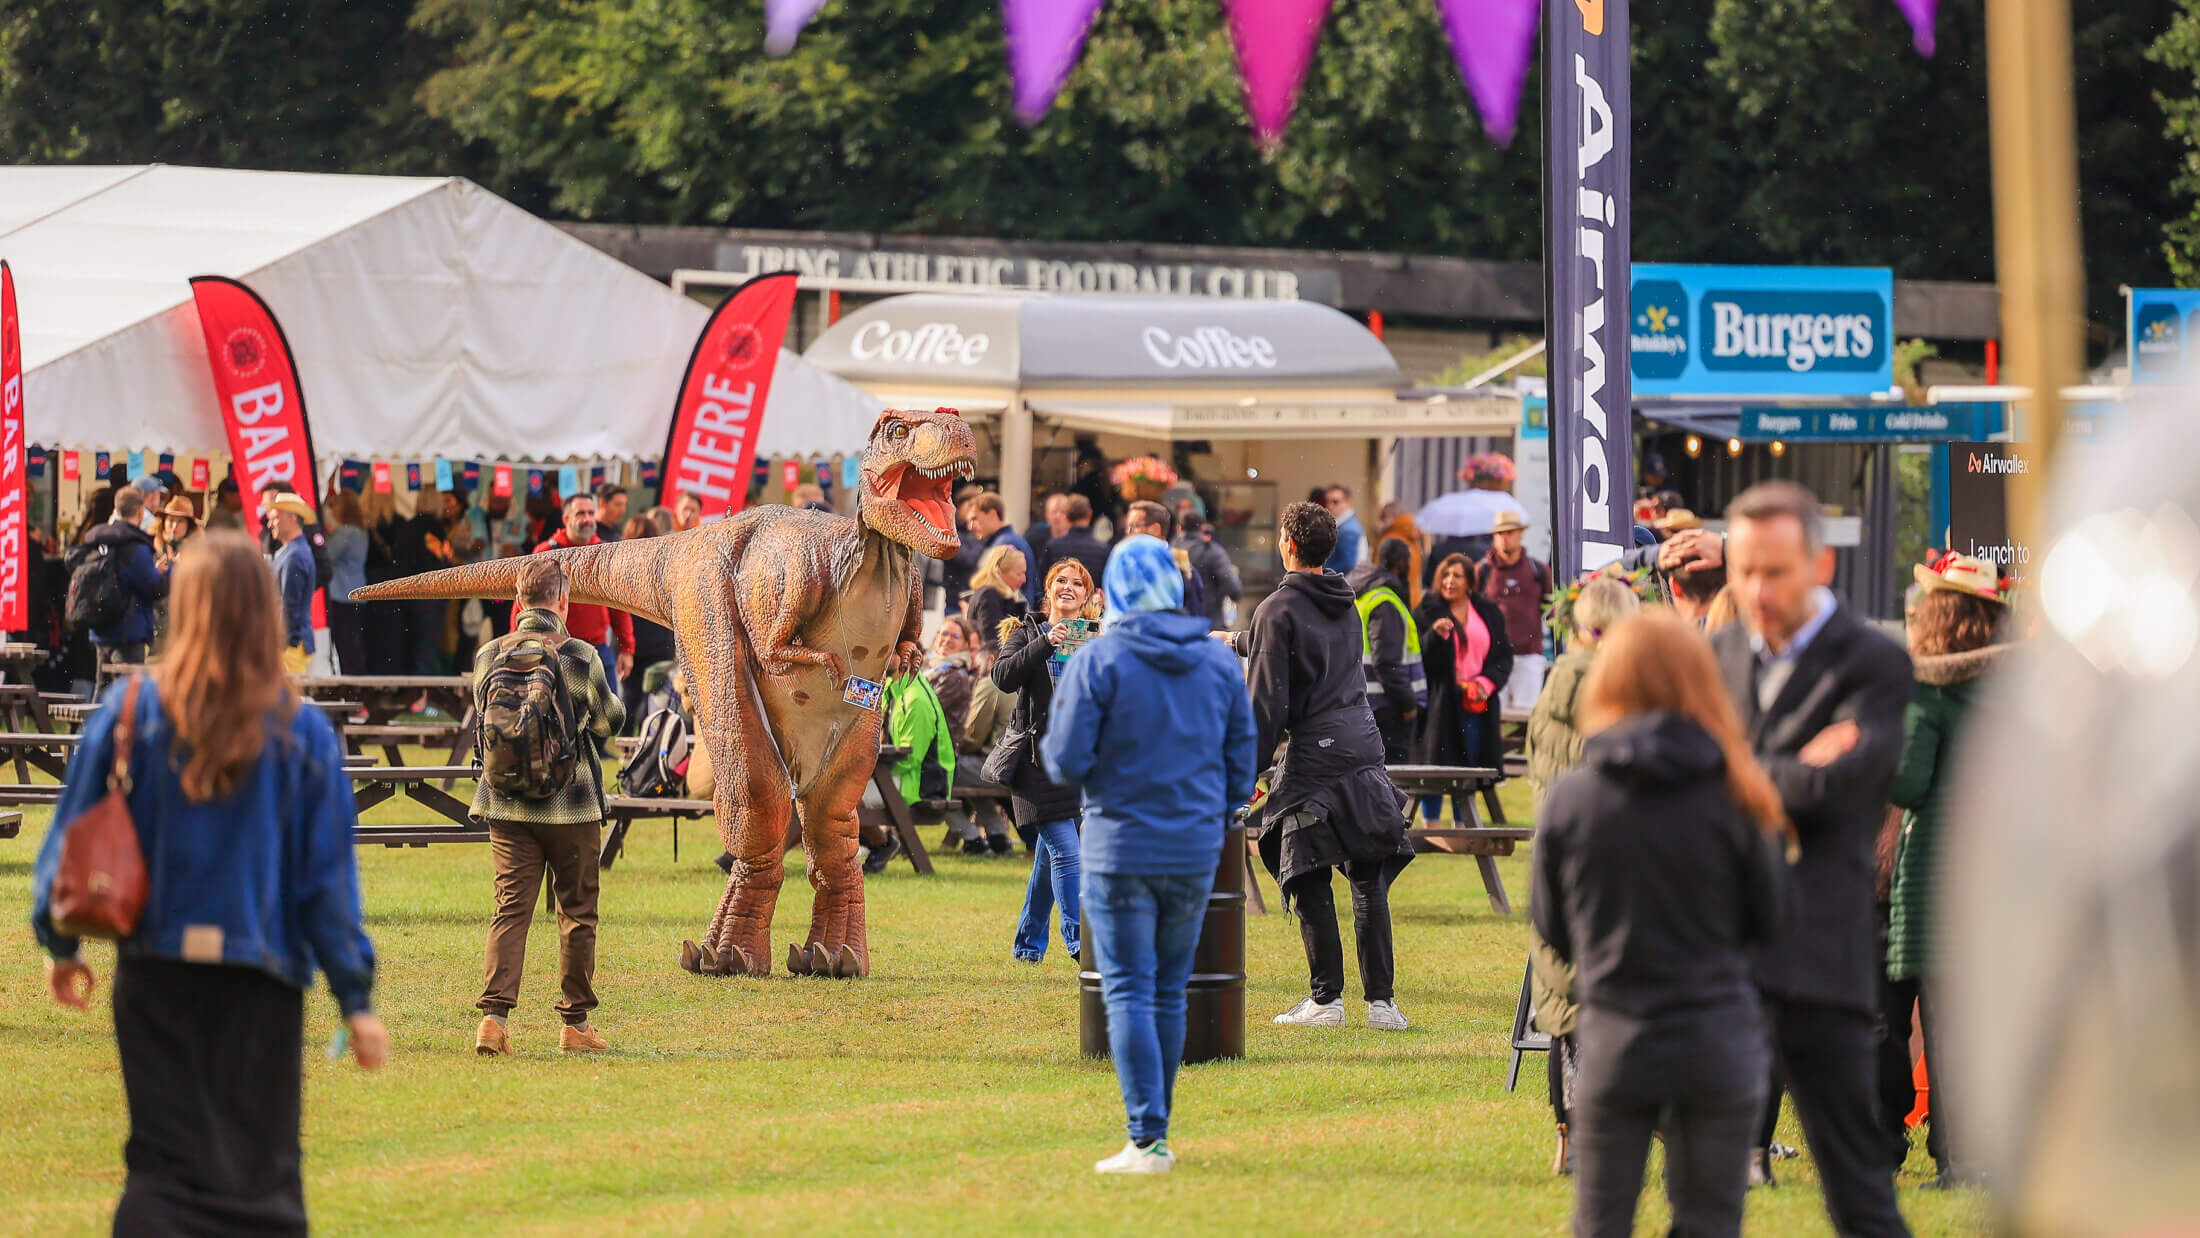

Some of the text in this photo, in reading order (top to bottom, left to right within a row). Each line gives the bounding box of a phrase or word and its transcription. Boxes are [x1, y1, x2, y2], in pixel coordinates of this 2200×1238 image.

[742, 245, 1299, 302] TRING ATHLETIC FOOTBALL CLUB
[850, 319, 990, 366] Coffee
[1141, 325, 1278, 369] Coffee
[1712, 302, 1874, 372] Burgers
[2, 374, 20, 480] BAR
[231, 381, 296, 492] BAR
[676, 372, 757, 501] HERE
[1983, 453, 2030, 474] Airwallex
[1970, 538, 2030, 565] Launch to
